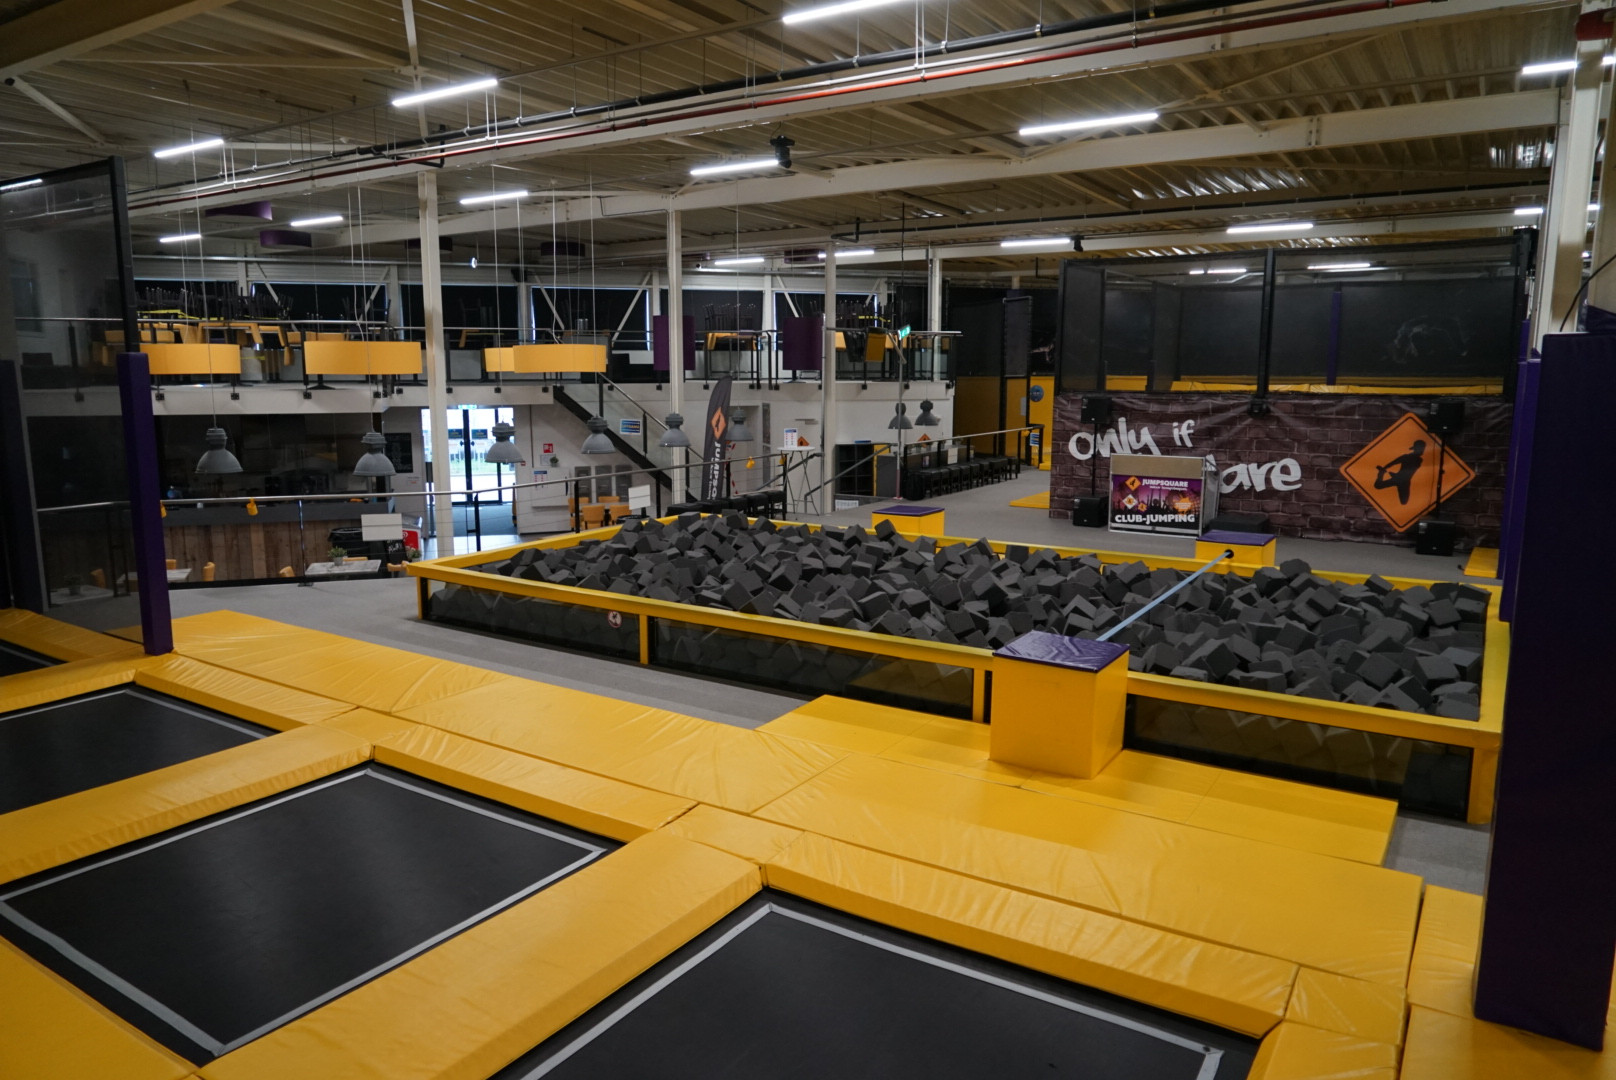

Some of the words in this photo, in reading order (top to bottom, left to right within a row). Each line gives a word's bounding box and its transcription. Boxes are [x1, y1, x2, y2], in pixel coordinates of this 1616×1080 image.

[1068, 417, 1162, 461] only
[1172, 419, 1196, 448] if
[711, 441, 721, 500] JUMPSQ
[1142, 478, 1189, 488] JUMPSQUARE
[1205, 454, 1302, 493] are
[1114, 514, 1196, 525] CLUB-JUMPING
